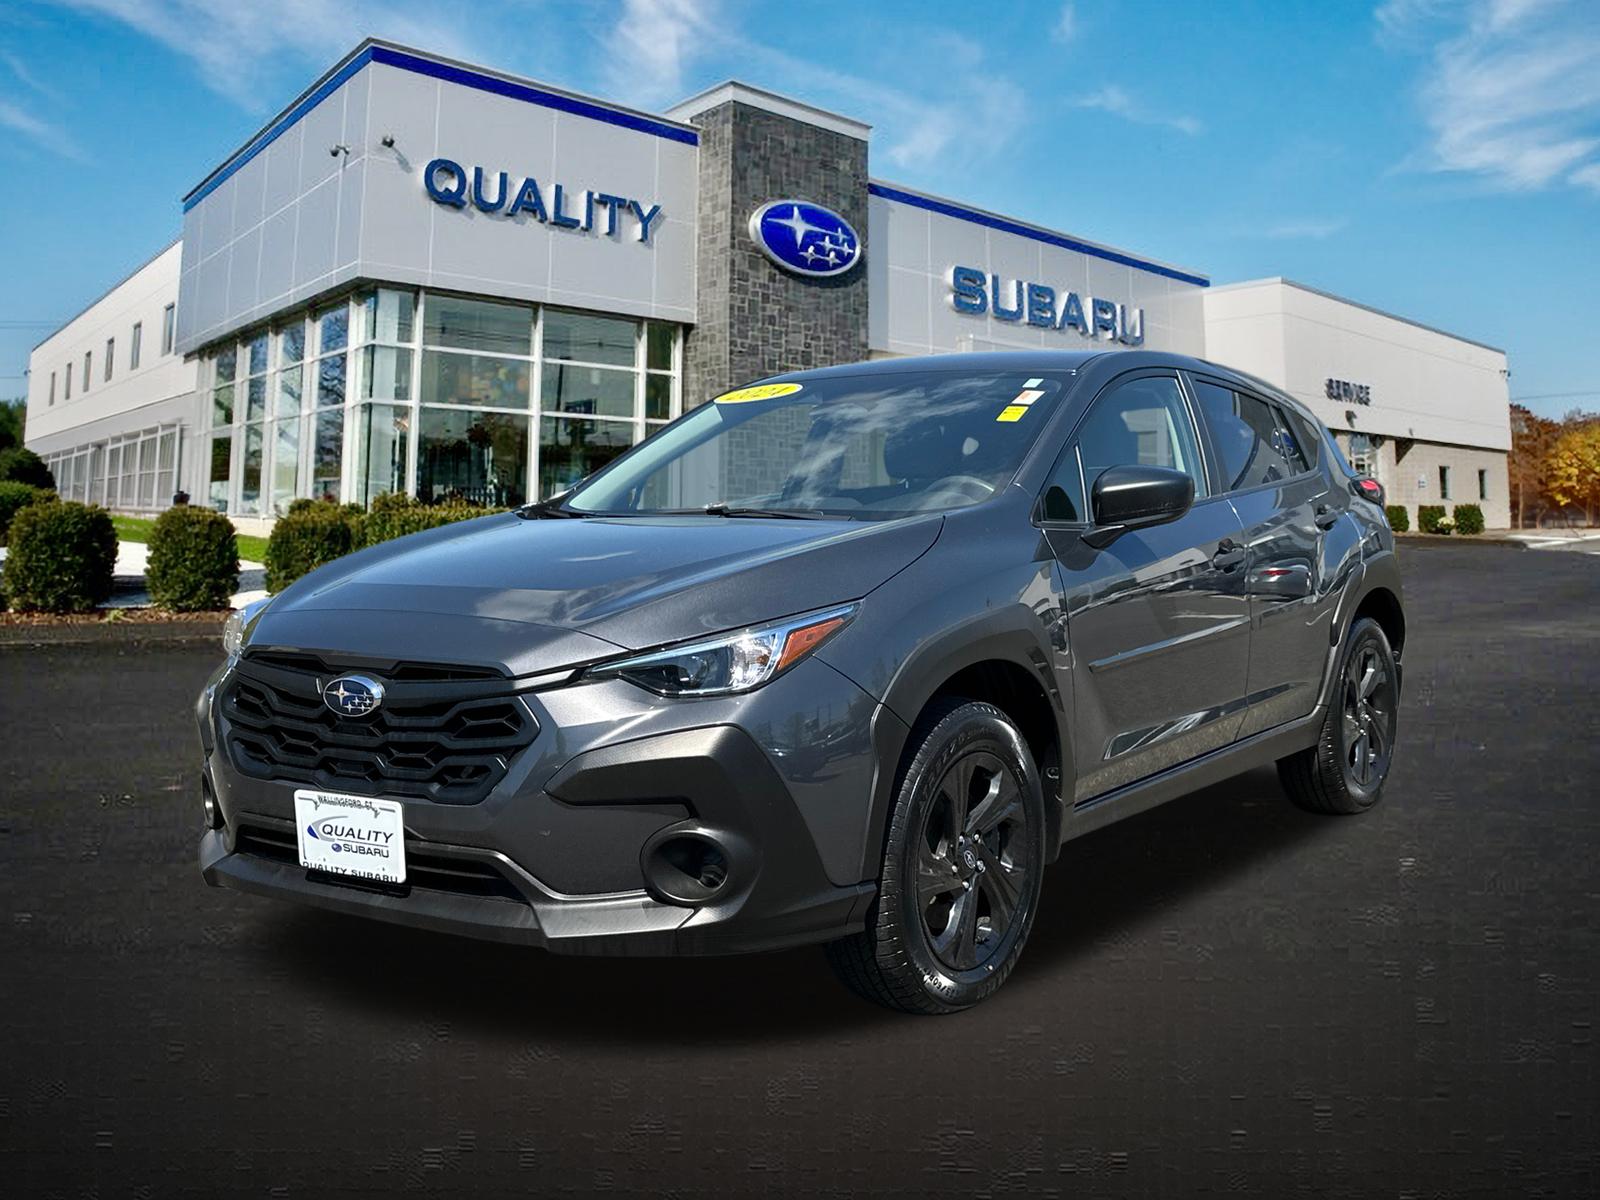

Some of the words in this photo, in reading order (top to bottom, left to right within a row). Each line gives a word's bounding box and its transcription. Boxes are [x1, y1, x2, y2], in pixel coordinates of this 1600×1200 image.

[424, 158, 661, 243] QUALITY
[951, 265, 1144, 347] SUBARU
[322, 824, 393, 843] QUALITY
[343, 843, 390, 858] SUBARU
[302, 861, 347, 875] QUALITY
[351, 869, 398, 882] SUBARU
